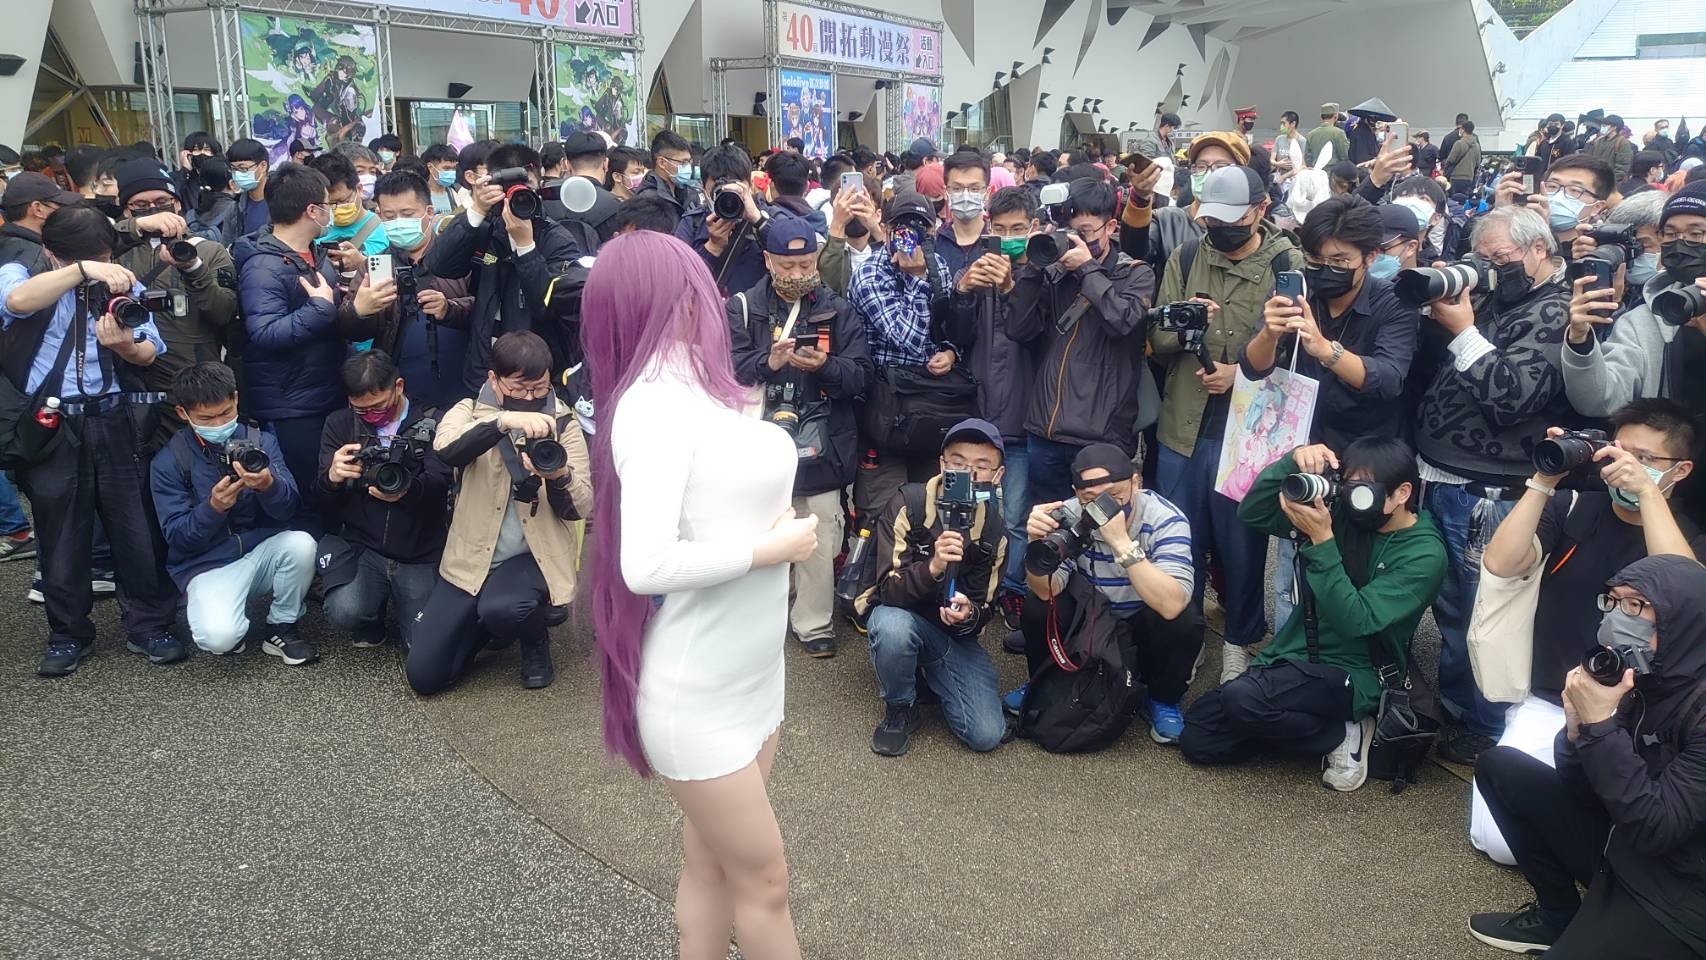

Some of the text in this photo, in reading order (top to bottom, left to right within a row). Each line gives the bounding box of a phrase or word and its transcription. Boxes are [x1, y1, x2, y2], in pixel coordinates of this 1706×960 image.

[592, 2, 619, 27] 入口
[819, 16, 911, 66] 開拓動漫祭
[922, 54, 934, 70] 入口
[319, 553, 332, 569] 97
